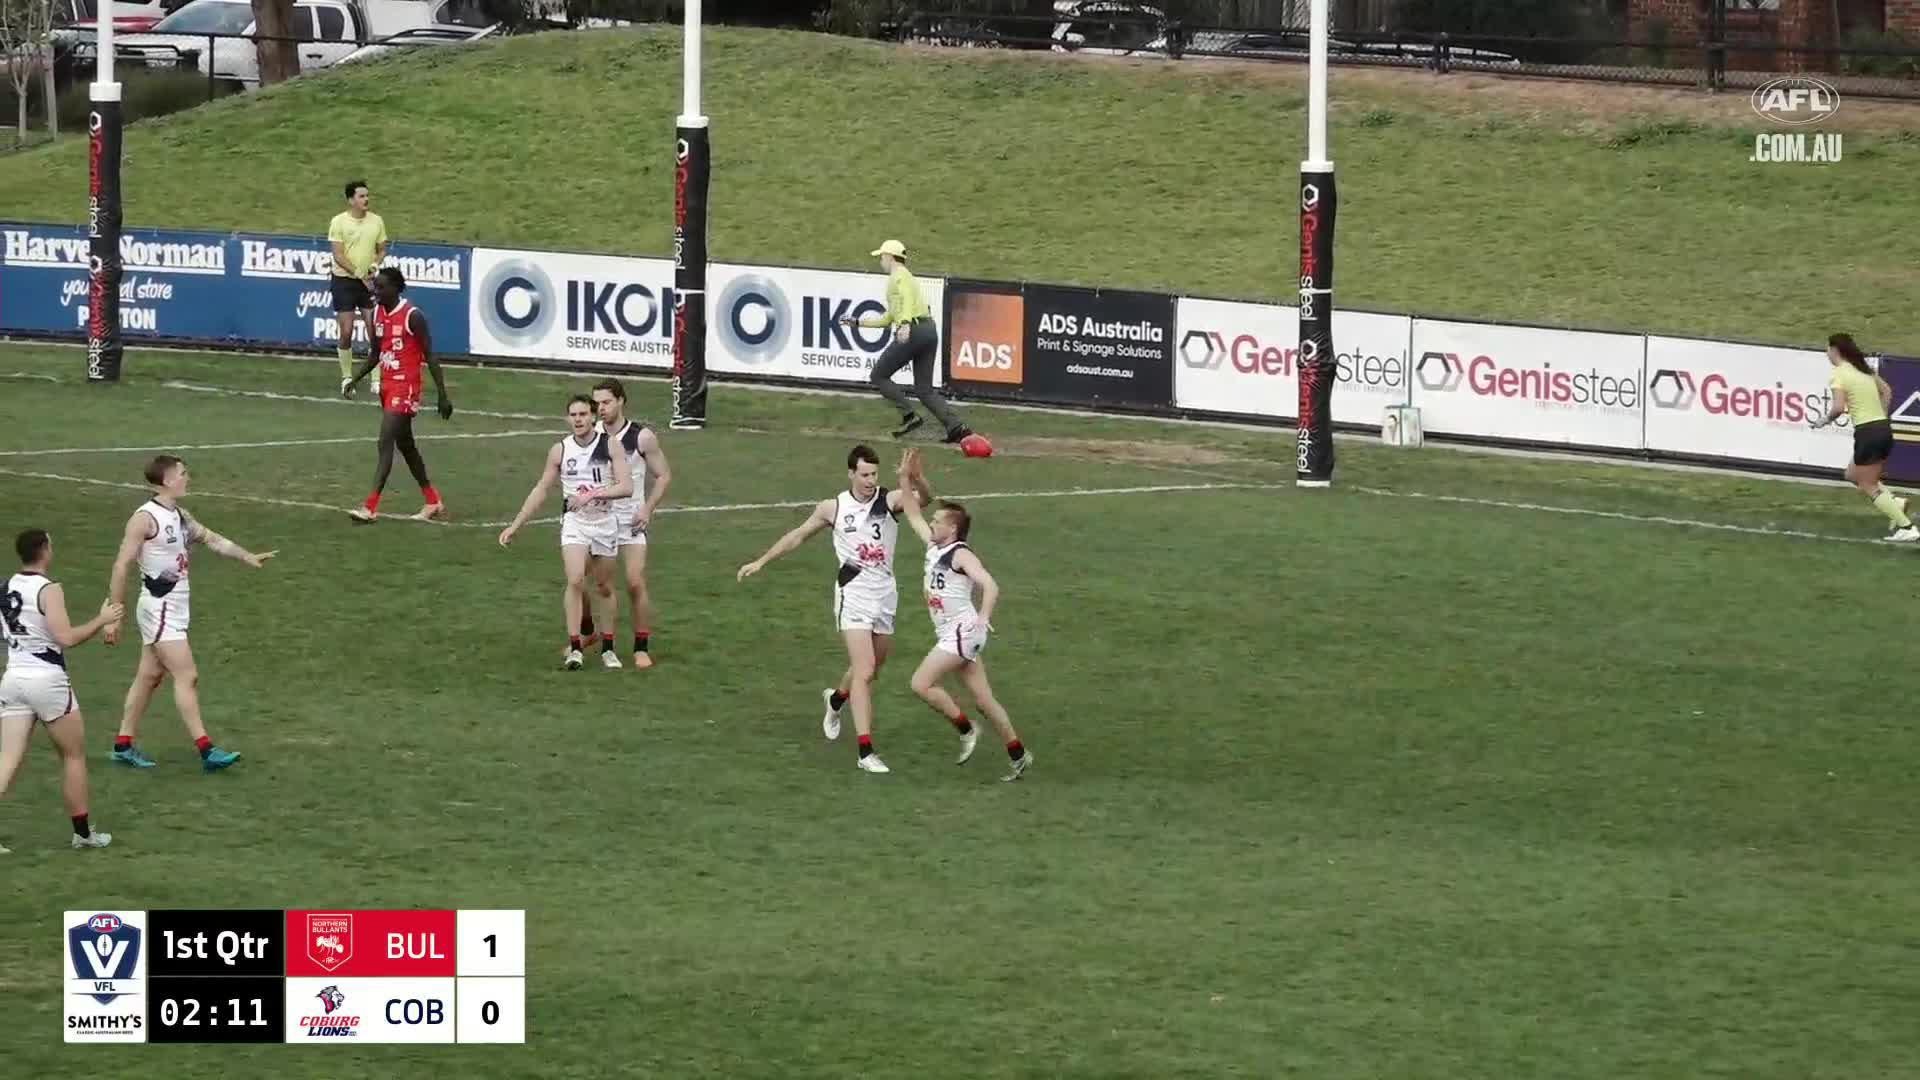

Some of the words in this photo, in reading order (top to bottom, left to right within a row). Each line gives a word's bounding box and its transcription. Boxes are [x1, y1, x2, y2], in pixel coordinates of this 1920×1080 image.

[4, 230, 91, 263] Harve
[241, 240, 334, 273] Harve
[60, 277, 90, 306] you
[137, 276, 173, 300] store
[296, 289, 334, 318] you
[77, 305, 157, 330] PTON
[802, 296, 893, 353] IKO
[1038, 313, 1077, 335] ADS
[1081, 316, 1163, 343] Australia
[566, 336, 627, 352] SERVICES
[957, 340, 1013, 370] ADS
[1037, 337, 1060, 350] Print
[1062, 339, 1071, 351] &
[1072, 341, 1115, 358] Signage
[1117, 343, 1162, 360] Solutions
[801, 353, 861, 369] SERVICES
[1066, 363, 1134, 379] adsaust.com.au
[1230, 333, 1406, 388] Gensteel
[1468, 355, 1641, 409] Genissteel
[1700, 373, 1849, 428] Genisst
[592, 467, 602, 483] 11
[871, 523, 881, 541] 3
[930, 572, 945, 591] 26
